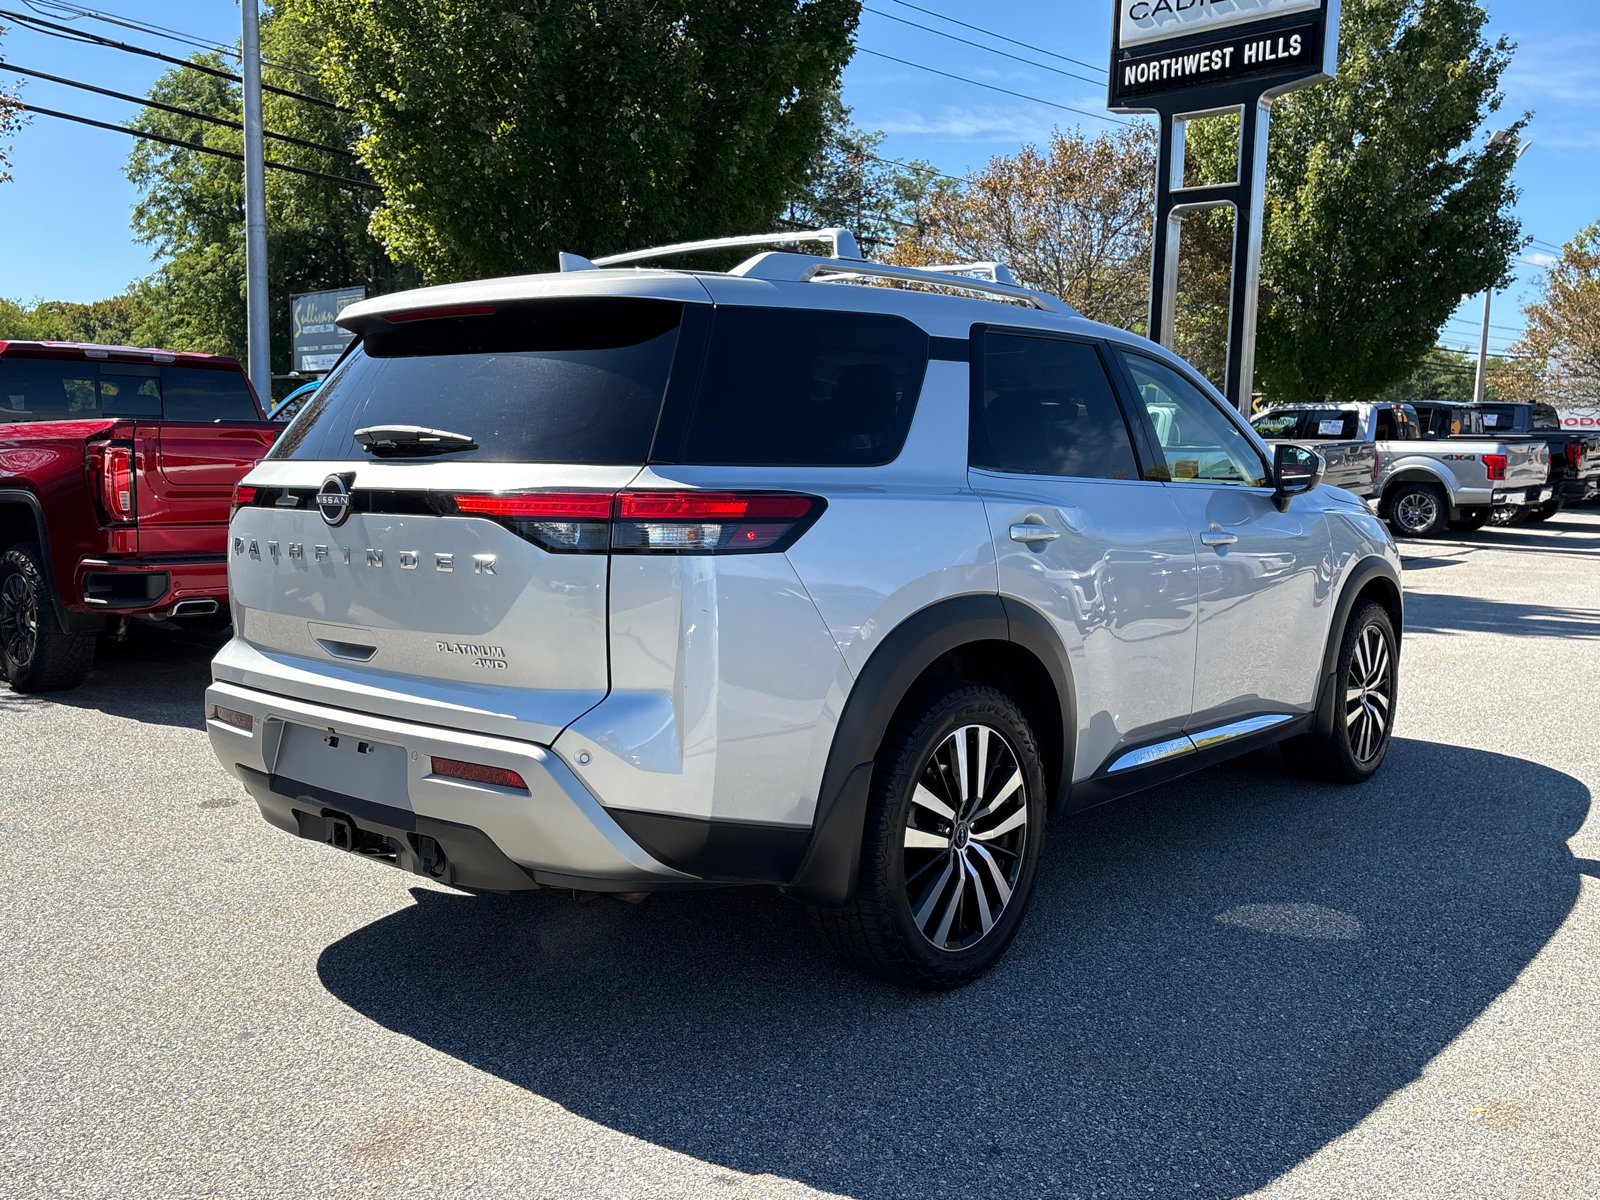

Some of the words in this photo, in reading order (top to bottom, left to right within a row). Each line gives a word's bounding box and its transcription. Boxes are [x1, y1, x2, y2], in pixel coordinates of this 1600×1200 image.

[1124, 47, 1234, 86] NORTHWEST
[1243, 34, 1302, 64] HILLS
[316, 494, 349, 505] NISSAN
[234, 538, 497, 575] PATHFINDER
[435, 641, 503, 658] PLATINUM
[471, 658, 507, 670] 4WD
[1133, 740, 1189, 762] PATHFINDER
